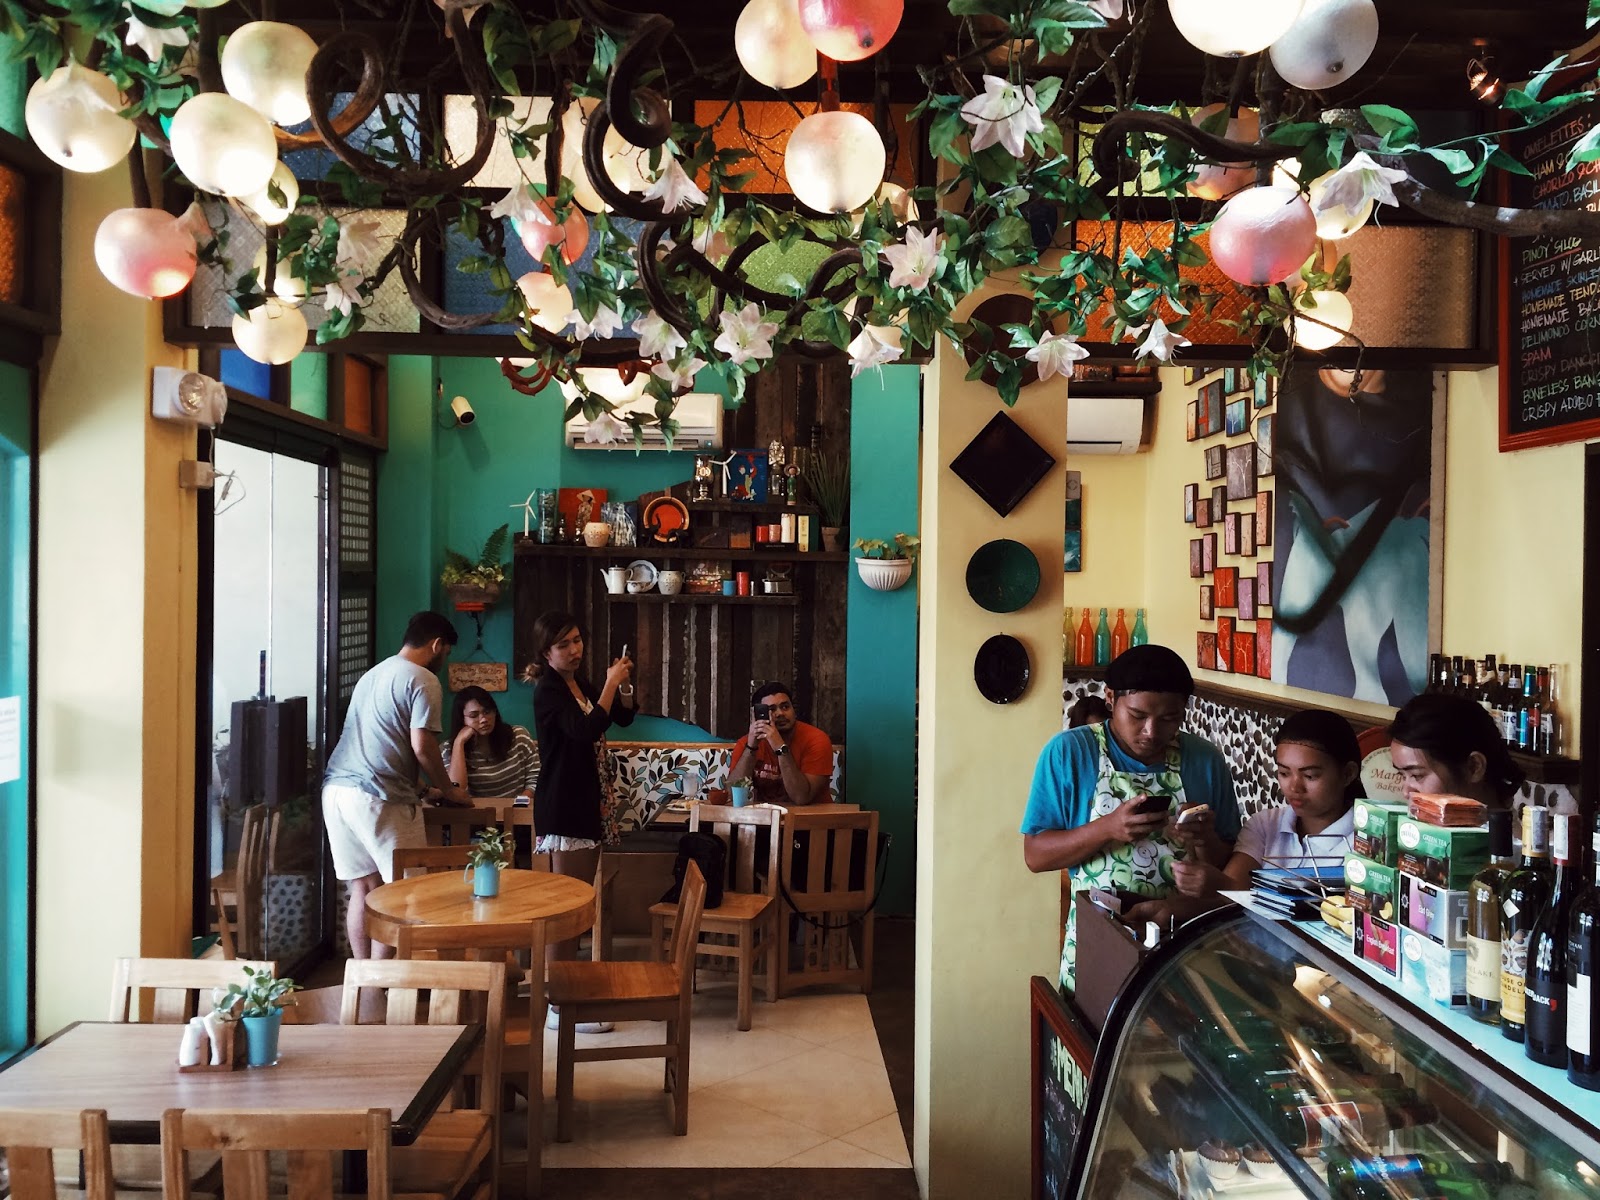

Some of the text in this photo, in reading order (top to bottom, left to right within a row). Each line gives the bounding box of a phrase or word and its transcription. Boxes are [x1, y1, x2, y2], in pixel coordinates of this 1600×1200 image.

[1533, 159, 1554, 180] HAM
[1533, 170, 1575, 200] CHORIZO
[1523, 243, 1550, 264] PINOY
[1521, 264, 1556, 285] SERVED
[1521, 294, 1566, 316] HOMEMADE
[1520, 308, 1570, 333] HOMEMADE
[1521, 346, 1552, 368] SPAM
[1523, 379, 1569, 404] BONELESS
[1522, 401, 1557, 422] CRISPY
[1560, 394, 1594, 413] ADOBO
[1371, 768, 1404, 784] Marg
[1422, 834, 1447, 847] GREEN TEA
[1368, 870, 1382, 880] GREEN
[1382, 875, 1391, 883] TEA
